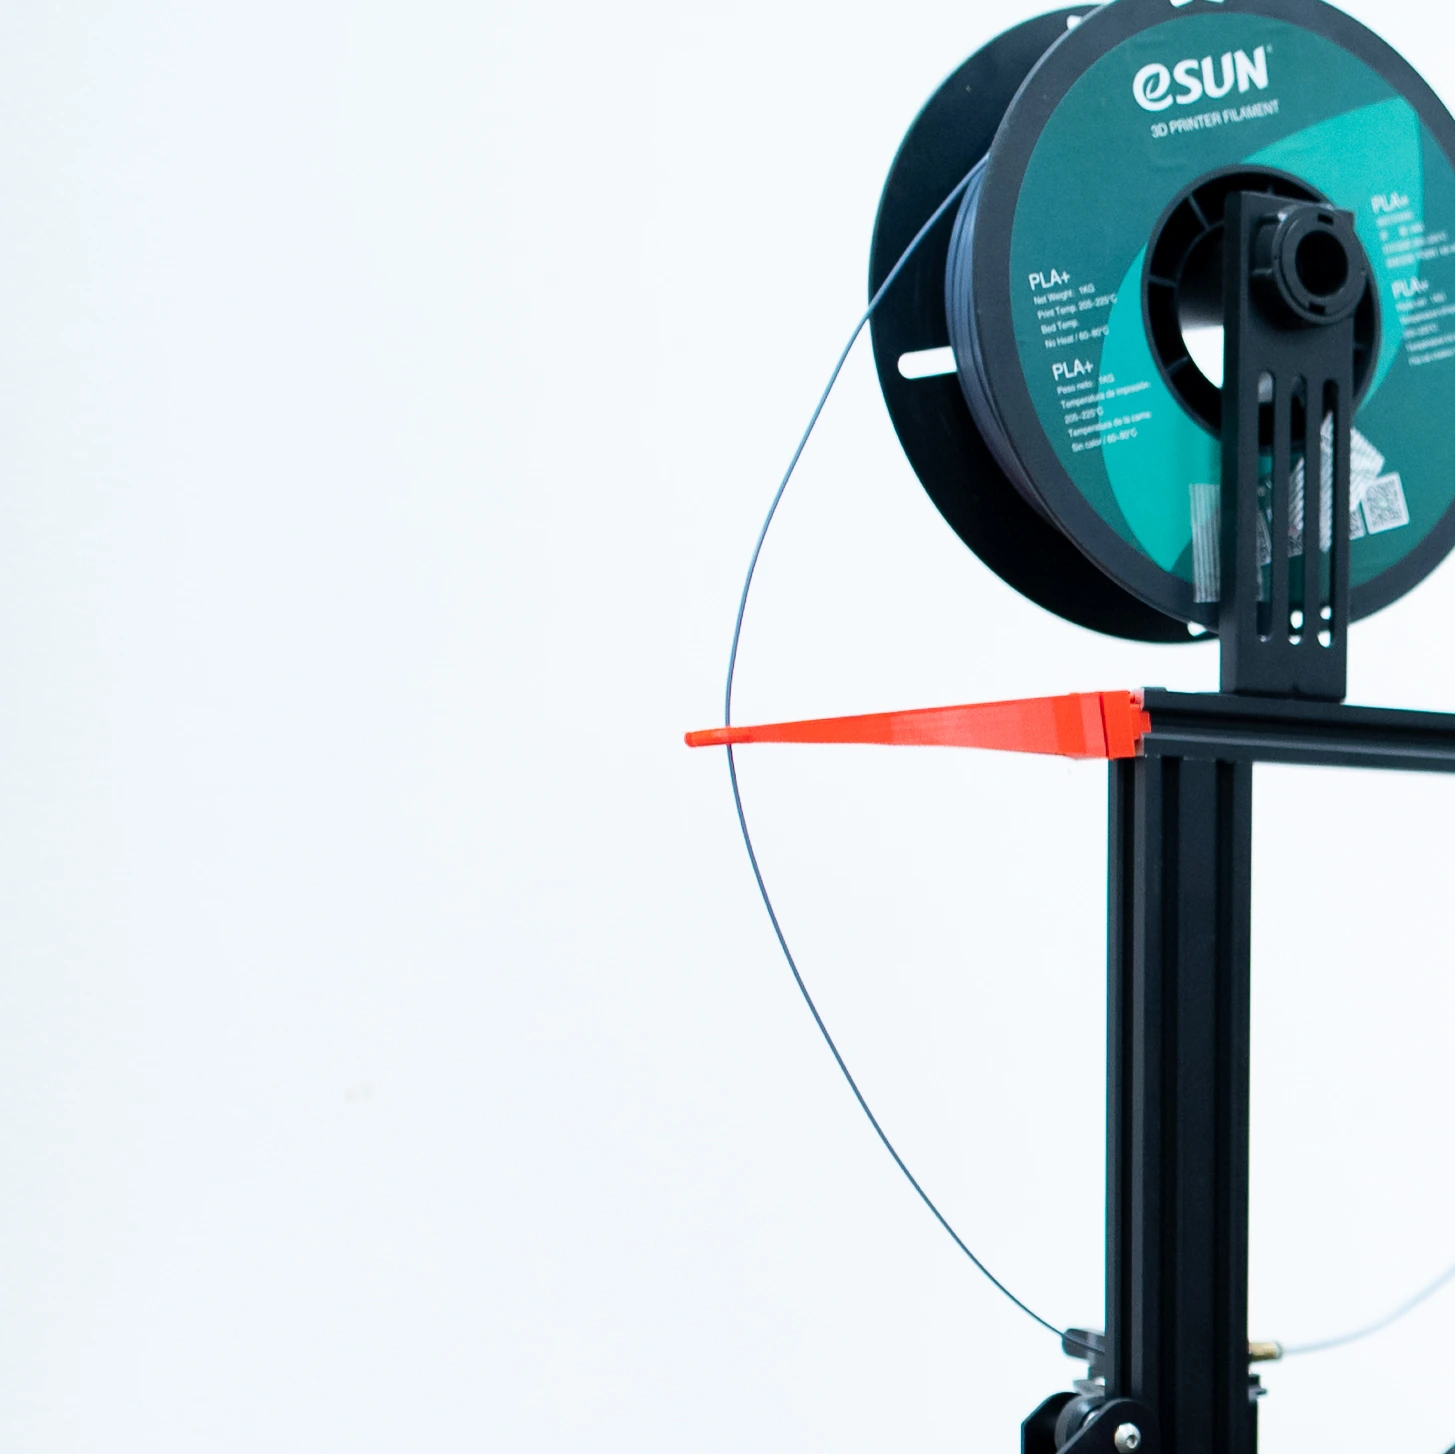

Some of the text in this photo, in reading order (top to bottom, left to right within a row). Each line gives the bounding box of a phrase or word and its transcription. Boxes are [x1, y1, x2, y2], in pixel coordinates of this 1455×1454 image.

[1151, 98, 1280, 139] 3D PRINTER FILAMENT
[1028, 268, 1071, 291] PLA+
[1037, 308, 1055, 319] Print
[1051, 358, 1094, 381] PLA+
